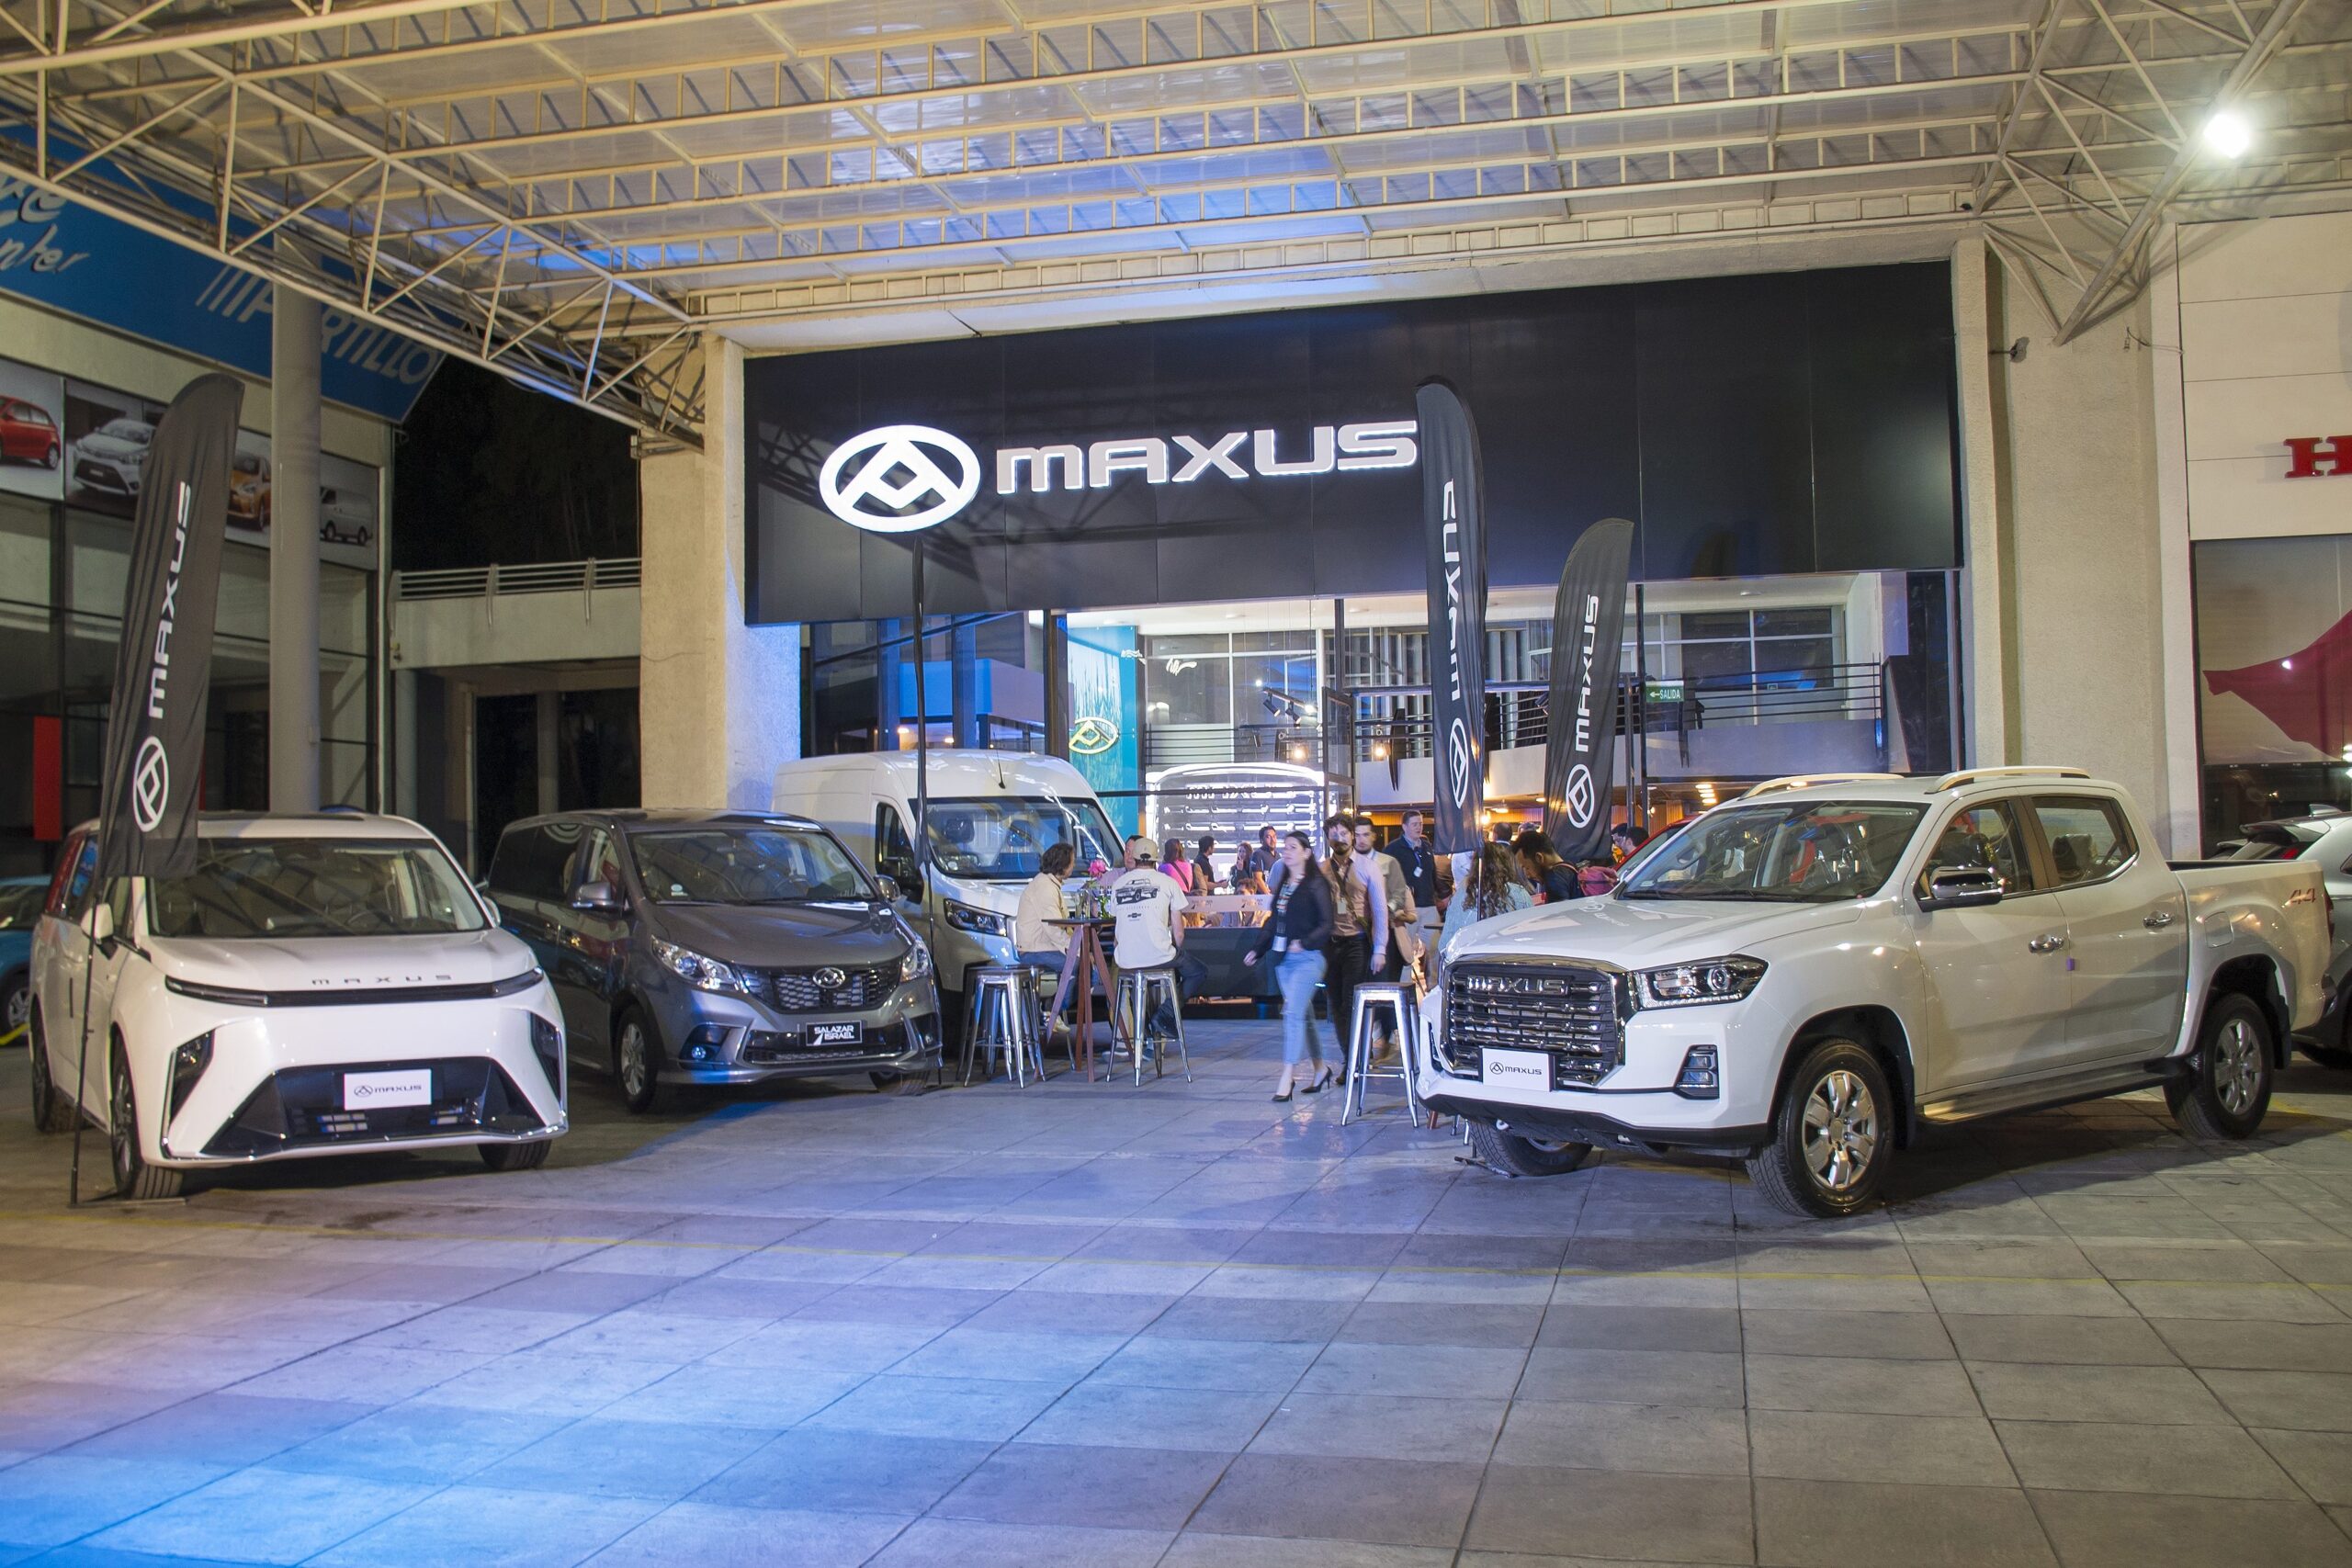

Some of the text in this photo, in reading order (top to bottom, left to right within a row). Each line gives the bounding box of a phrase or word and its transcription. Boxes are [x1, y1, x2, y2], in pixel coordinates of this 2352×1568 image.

[997, 421, 1419, 494] MAXUS
[148, 481, 191, 718] MAXUS
[1575, 594, 1599, 752] MAXUS
[1659, 689, 1680, 699] SALIDA
[311, 975, 452, 985] MAXUS
[1467, 975, 1567, 993] MAXUS
[814, 1025, 854, 1034] SALAZAR
[824, 1032, 854, 1040] ISRAEL
[1505, 1066, 1543, 1076] MAXUS
[374, 1085, 423, 1093] MAXUS
